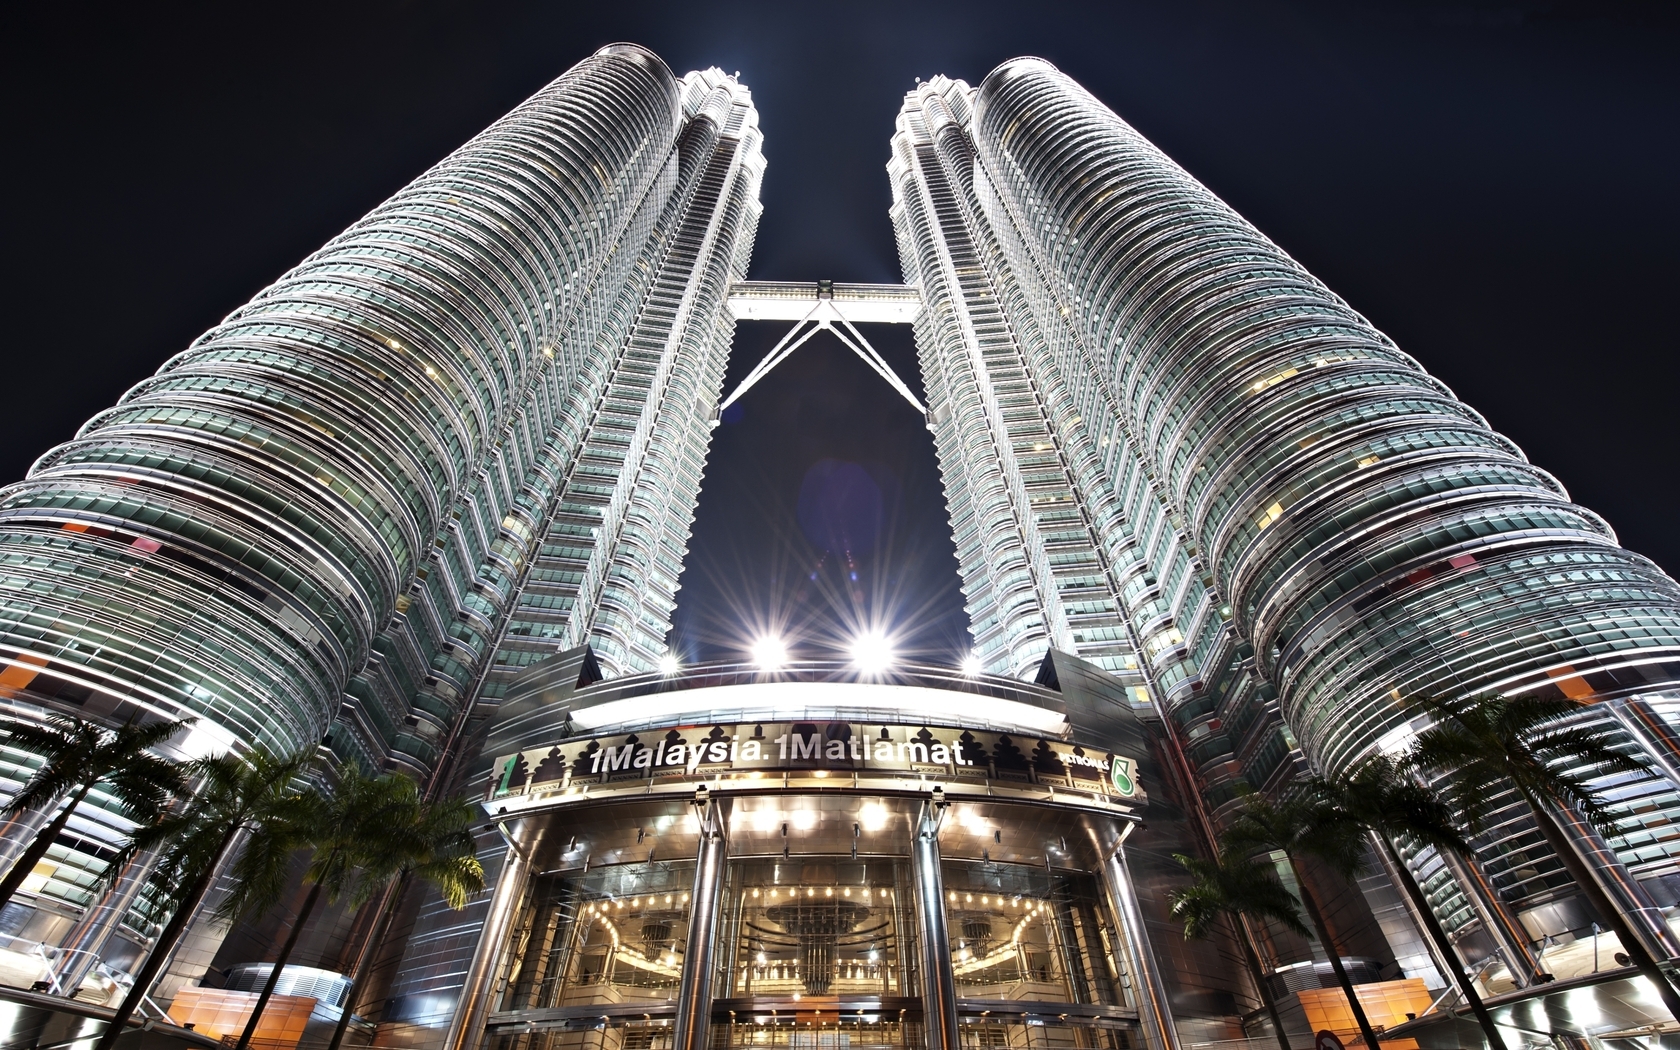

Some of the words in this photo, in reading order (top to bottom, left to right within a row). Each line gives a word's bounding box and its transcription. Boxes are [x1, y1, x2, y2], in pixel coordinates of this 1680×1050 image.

[589, 734, 769, 774] 1Malaysia.
[774, 733, 973, 766] 1Matlamat.
[1058, 752, 1110, 771] PETRONAS
